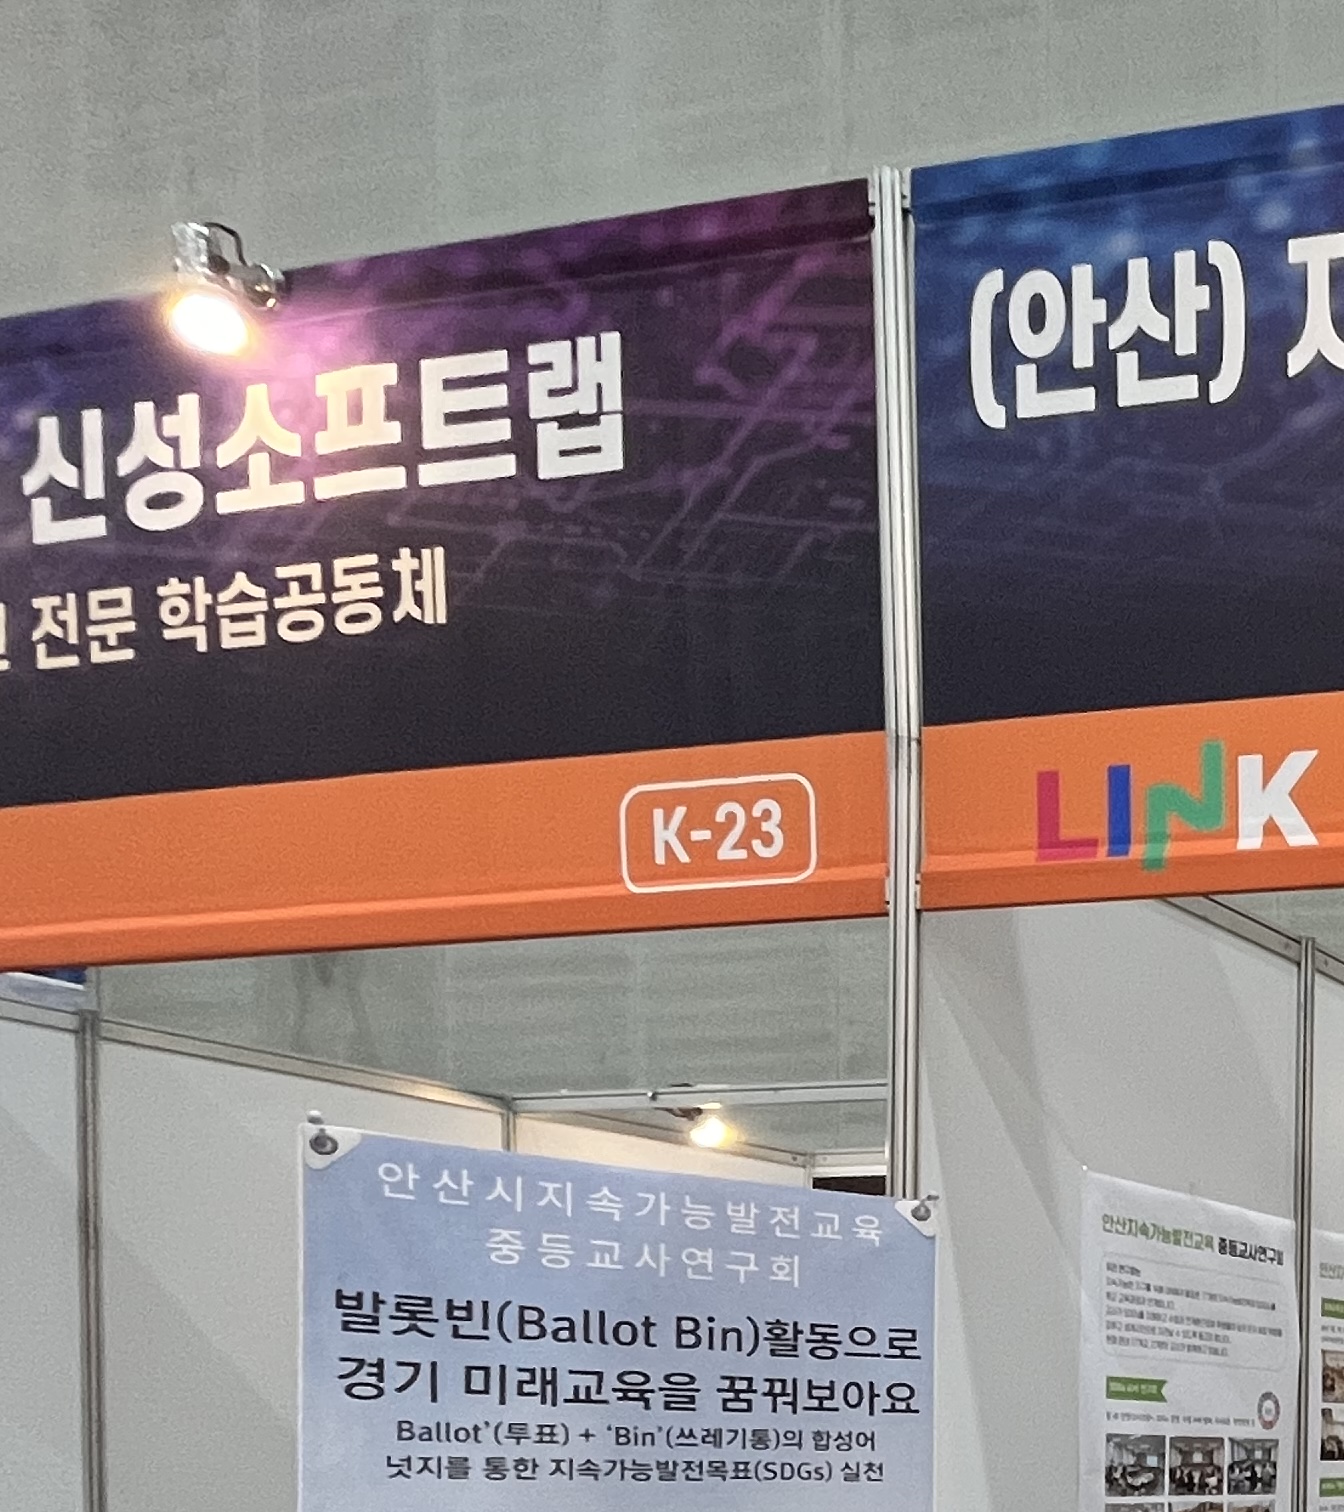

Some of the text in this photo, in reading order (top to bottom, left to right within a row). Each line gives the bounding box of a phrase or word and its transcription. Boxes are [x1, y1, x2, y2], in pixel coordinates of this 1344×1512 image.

[970, 240, 1246, 429] (안산)
[21, 330, 625, 545] 신성소프트랩
[31, 587, 136, 670] 전문
[157, 546, 448, 652] 학습공동체
[652, 799, 785, 866] K-23
[1035, 739, 1319, 870] LINK
[378, 1161, 884, 1248] 안산시지속가능발전교육
[486, 1228, 801, 1288] 중등교사연구회
[675, 1315, 921, 1362] Bin)활동으로
[336, 1356, 920, 1416] 경기 미래교육을 꿈꿔보아요
[386, 1456, 884, 1484] 넛지를 통한 지속가능발전목표(SDGs) 실천
[812, 1428, 876, 1453] 합성어
